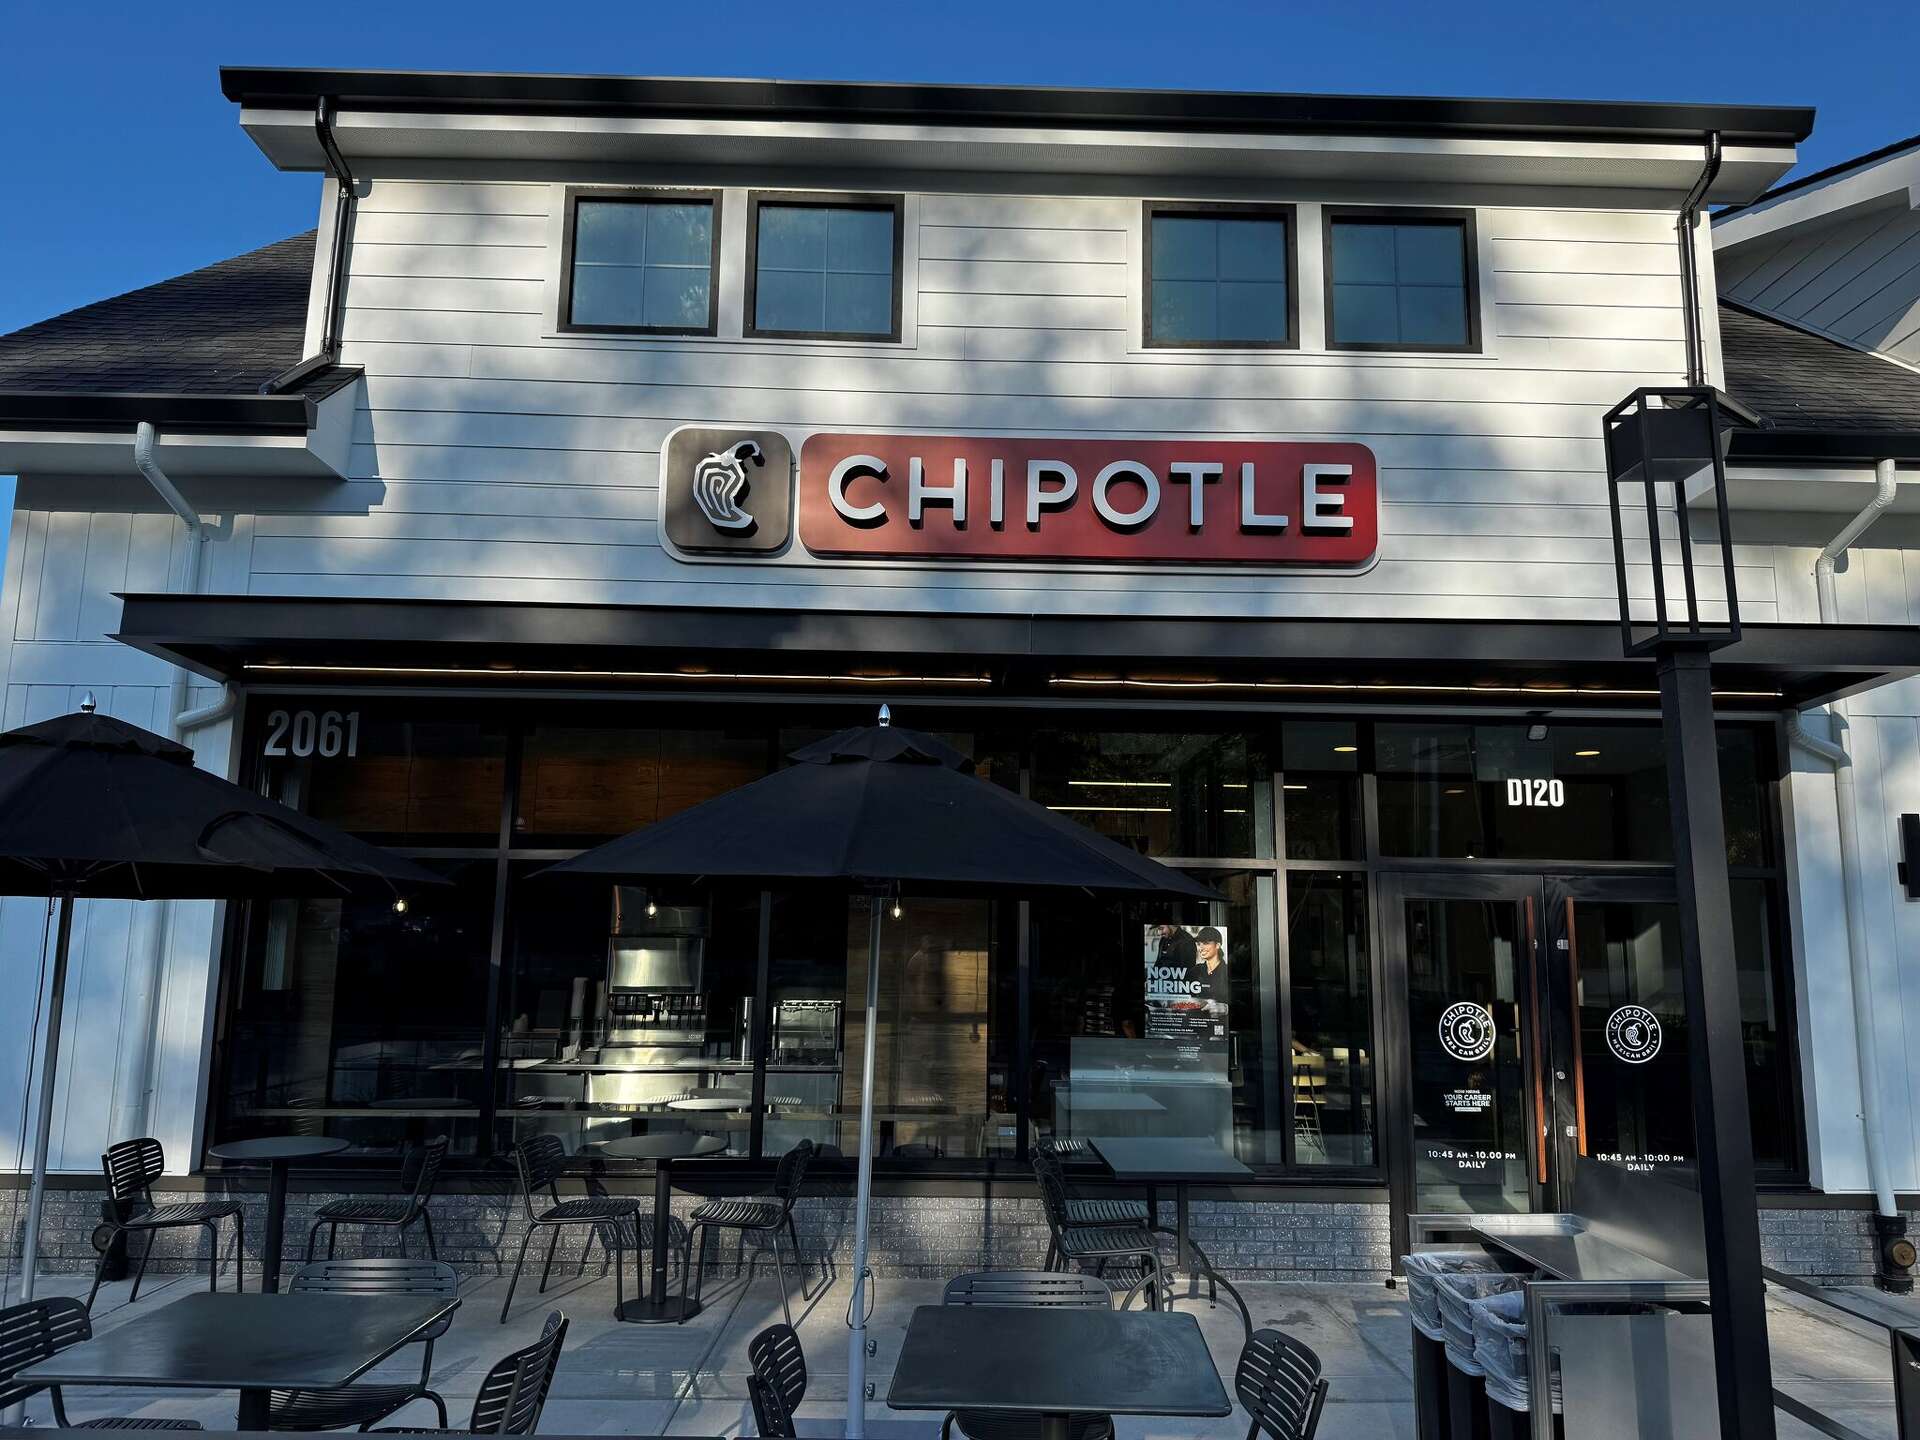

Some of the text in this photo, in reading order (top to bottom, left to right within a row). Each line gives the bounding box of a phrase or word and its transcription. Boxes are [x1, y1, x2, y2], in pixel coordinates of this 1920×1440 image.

[828, 454, 1353, 528] CHIPOTLE
[264, 710, 360, 757] 2061
[1507, 779, 1564, 807] D120
[1147, 966, 1187, 980] NOW
[1147, 979, 1201, 994] HIRING
[1443, 1006, 1491, 1028] CHIPOTLE
[1610, 1009, 1657, 1031] CHIPOTLE
[1445, 1035, 1475, 1056] MEXCAN
[1612, 1038, 1657, 1058] MEXICAN GRILL
[1428, 1150, 1453, 1158] 10:45
[1596, 1153, 1622, 1161] 10:45
[1643, 1154, 1670, 1162] 10:00
[1458, 1160, 1486, 1169] DAILY
[1627, 1163, 1655, 1171] DAILY
